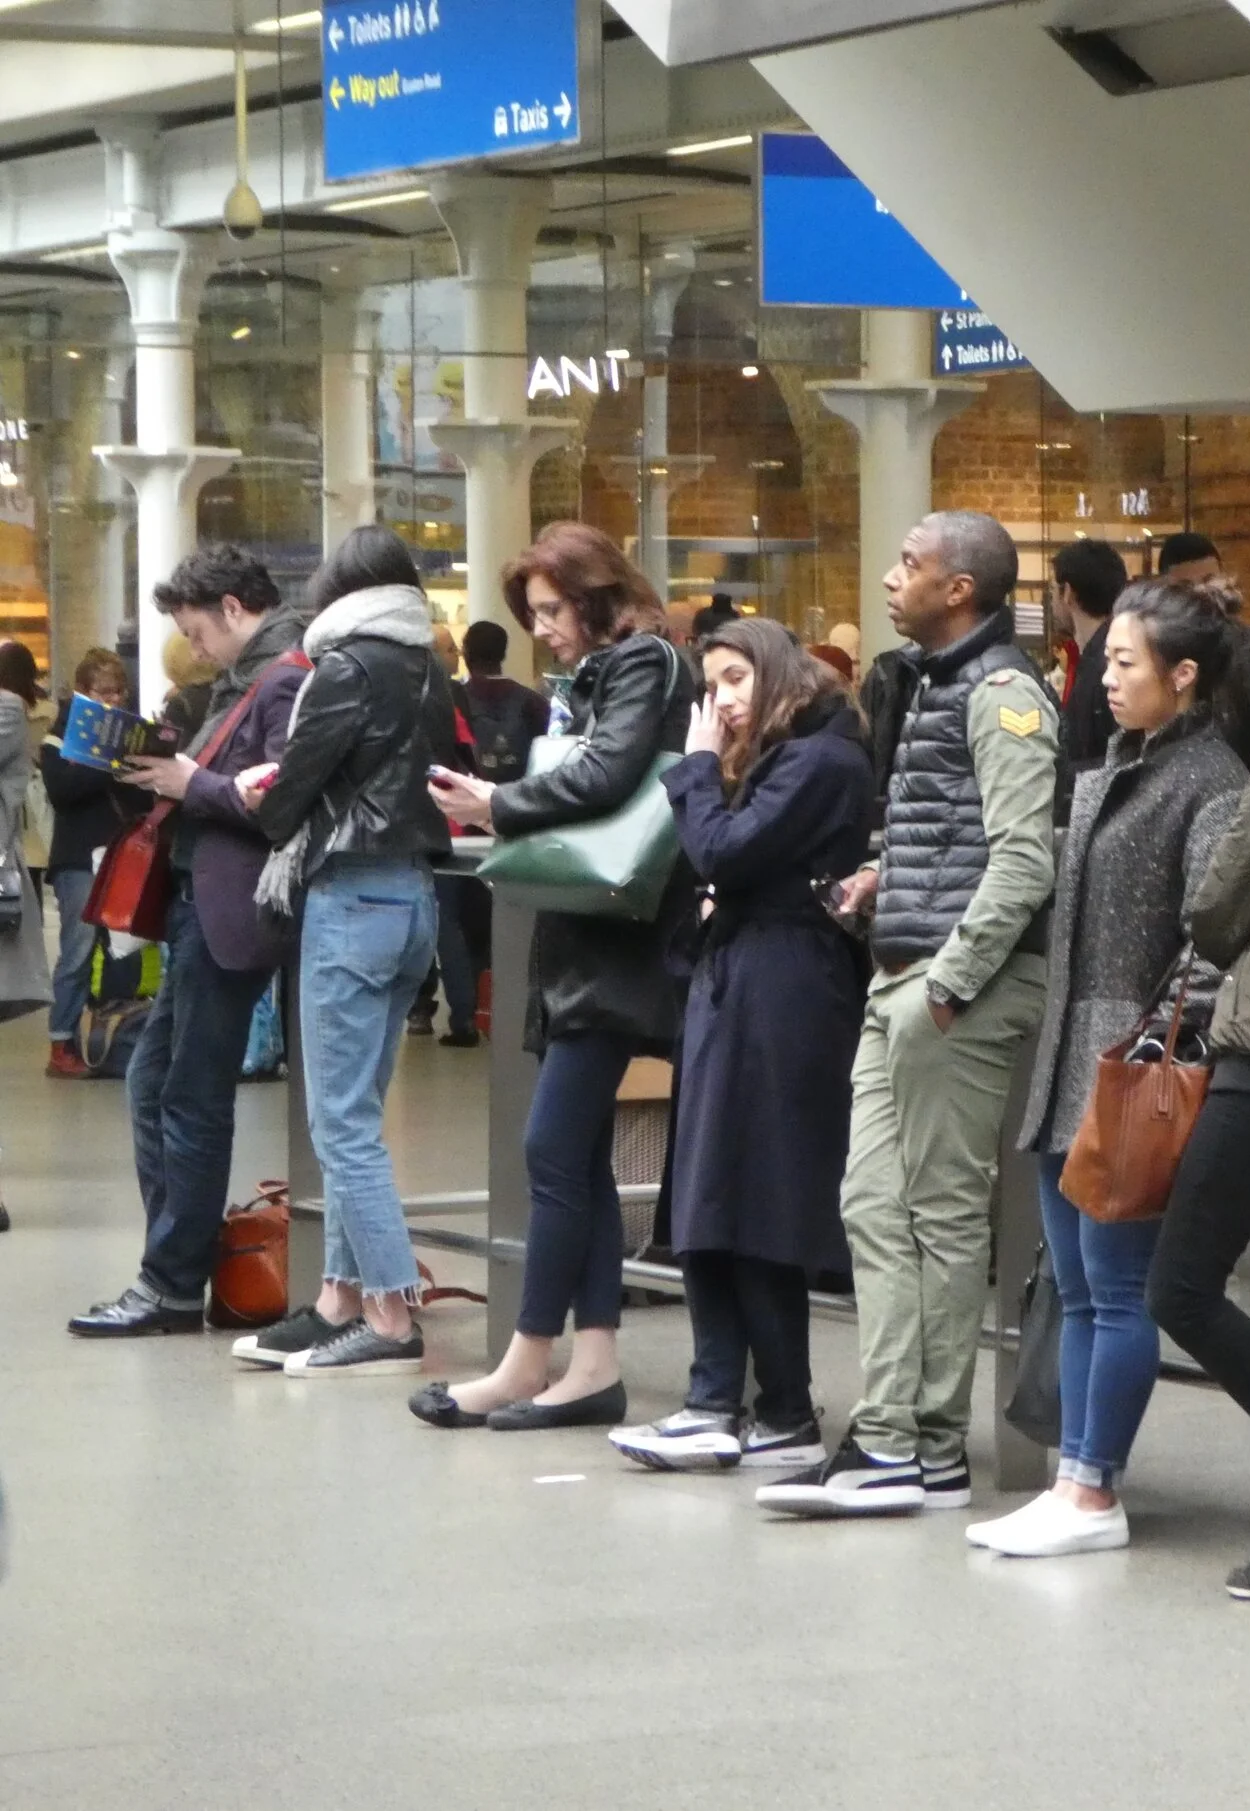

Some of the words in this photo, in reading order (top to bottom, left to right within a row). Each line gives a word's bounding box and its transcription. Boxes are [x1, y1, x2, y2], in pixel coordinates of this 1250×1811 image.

[348, 11, 391, 46] Toilets
[349, 73, 376, 108] Way
[378, 68, 400, 99] out
[510, 98, 549, 134] Taxis
[956, 343, 990, 364] Toilets
[527, 349, 630, 400] ANT
